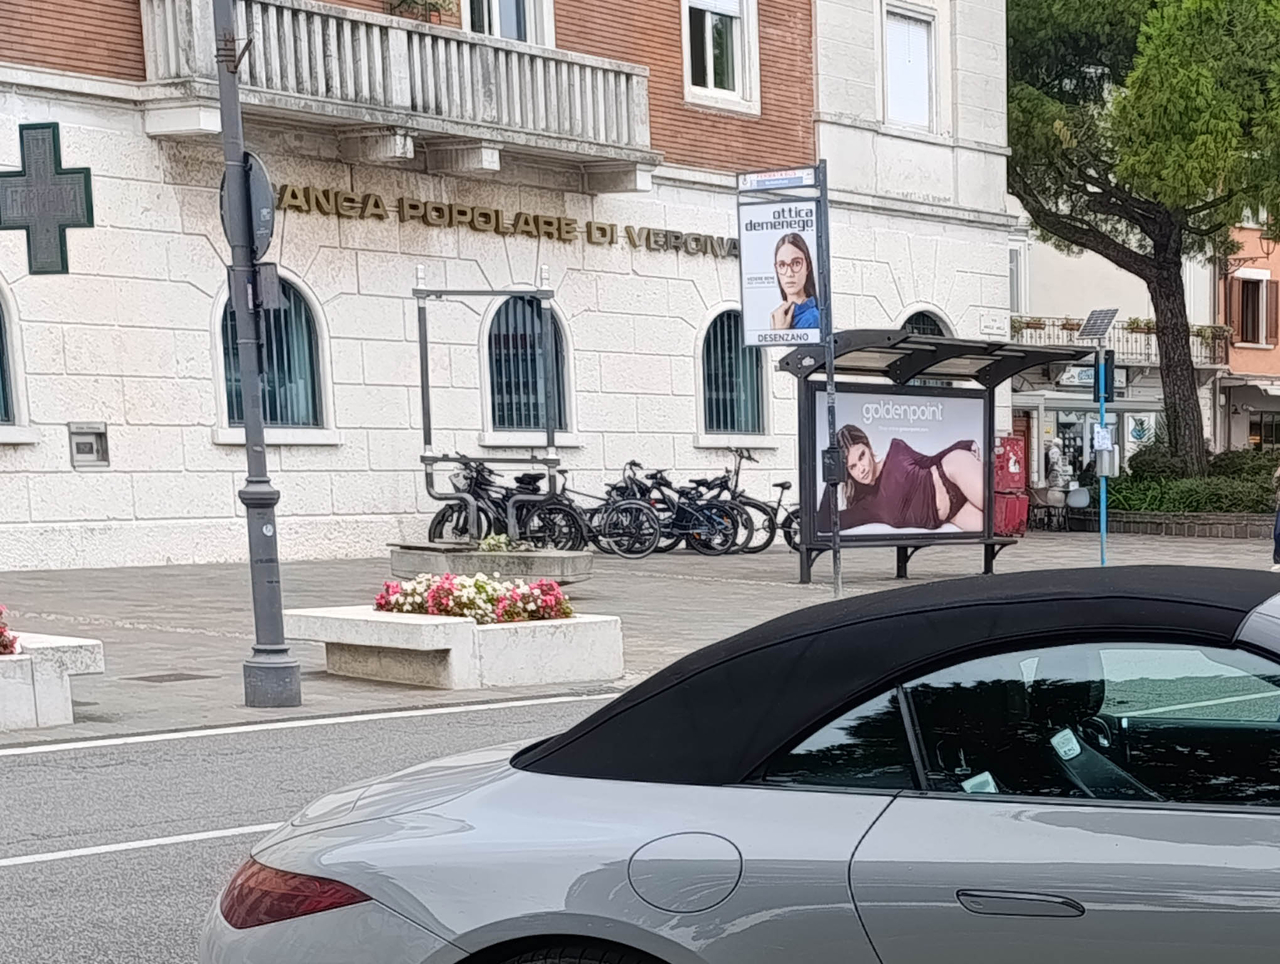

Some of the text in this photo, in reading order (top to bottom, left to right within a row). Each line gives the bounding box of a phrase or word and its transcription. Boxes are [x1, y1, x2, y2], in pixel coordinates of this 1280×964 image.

[273, 184, 390, 220] ANCA
[397, 197, 578, 242] POPOLARE
[586, 220, 619, 246] DI
[772, 206, 814, 220] ottica
[745, 219, 814, 232] demenego
[757, 332, 809, 343] DESENZANO
[862, 400, 943, 424] goldenpoint
